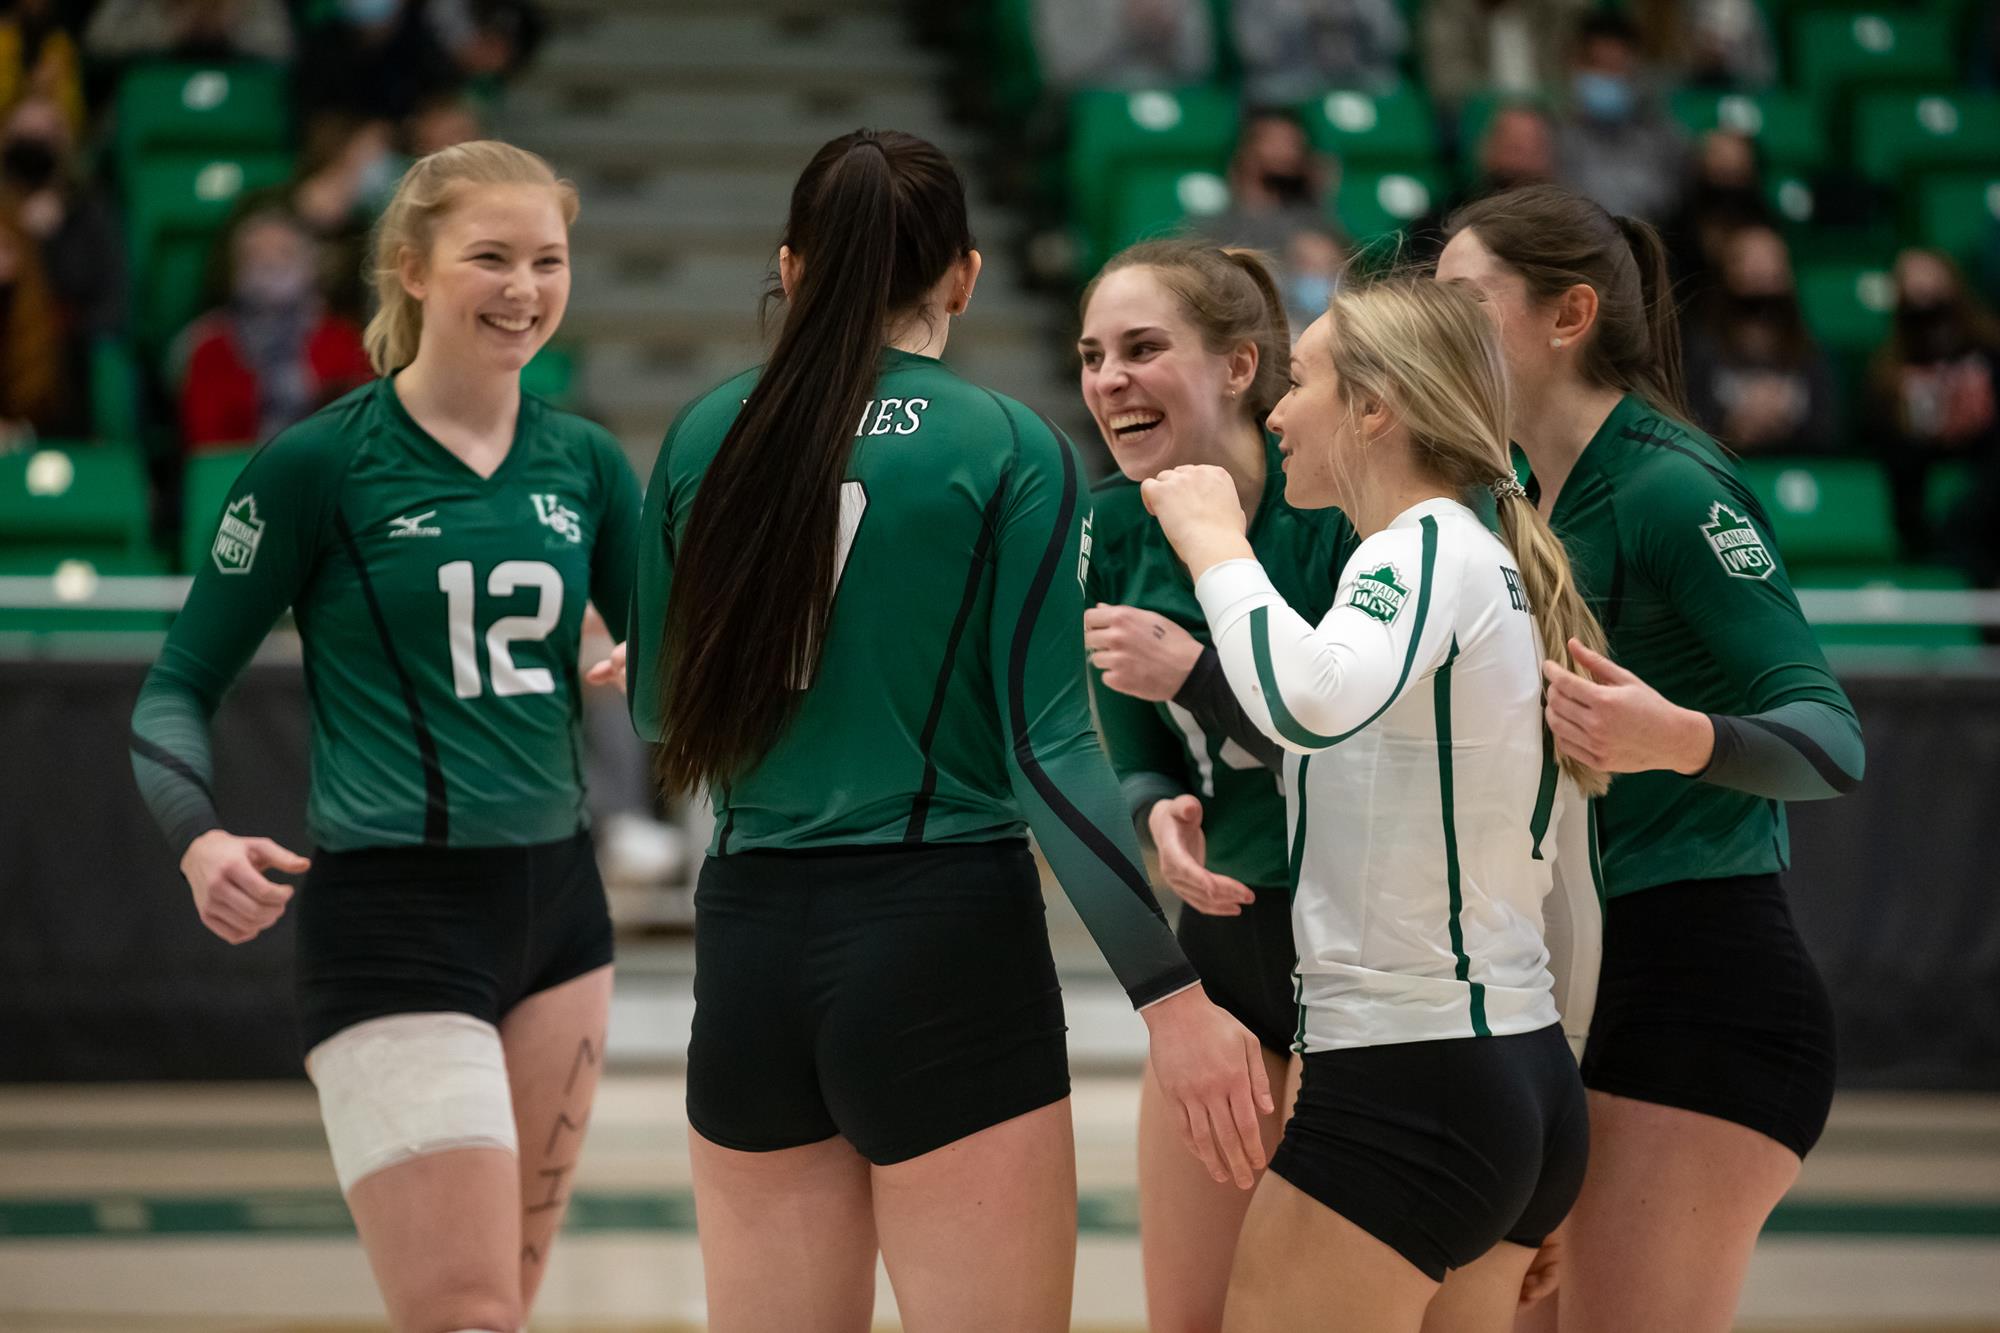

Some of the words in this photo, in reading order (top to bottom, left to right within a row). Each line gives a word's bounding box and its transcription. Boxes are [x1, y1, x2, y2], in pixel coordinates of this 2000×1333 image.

[216, 532, 251, 568] WEST
[1714, 530, 1758, 549] CANADA
[1724, 547, 1770, 571] WEST
[1355, 591, 1396, 617] WEST
[1357, 580, 1400, 606] CANADA
[438, 561, 564, 698] 12
